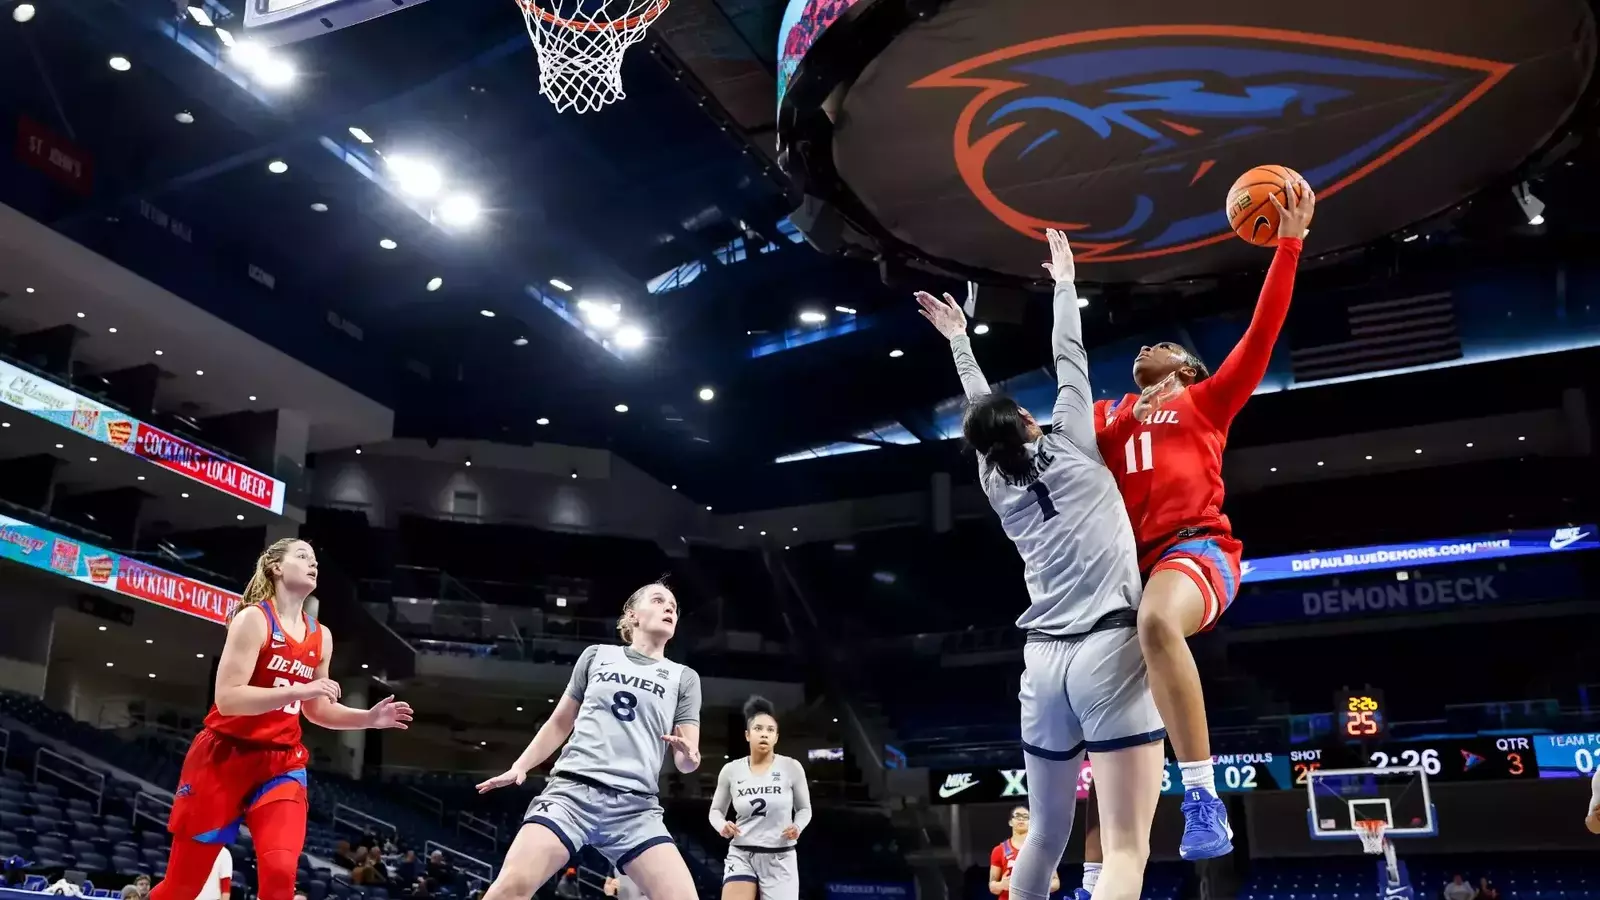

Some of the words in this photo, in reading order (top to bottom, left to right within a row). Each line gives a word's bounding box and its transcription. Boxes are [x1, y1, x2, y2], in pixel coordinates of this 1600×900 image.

[1140, 410, 1180, 426] AUL
[1124, 431, 1154, 475] 11
[143, 431, 202, 473] COCKTAILS
[206, 457, 237, 488] LOCAL
[240, 471, 267, 500] BEER
[1027, 479, 1060, 523] 1
[1554, 527, 1581, 541] NIKE
[126, 565, 186, 604] COCKTAILS
[191, 586, 223, 616] LOCAL
[1303, 583, 1409, 616] DEMON
[1414, 575, 1499, 606] DECK
[288, 659, 315, 680] PAUL
[596, 672, 666, 700] XAVIER
[611, 690, 638, 722] 8
[1349, 697, 1378, 711] 2:26
[1347, 711, 1377, 735] 25
[1496, 737, 1529, 751] QTR
[1549, 734, 1585, 747] TEAM
[1212, 754, 1235, 766] EAM
[1236, 752, 1273, 765] FOULS
[1290, 749, 1322, 761] SHOT
[1370, 748, 1441, 775] 2:26
[1507, 752, 1524, 775] 3
[944, 772, 973, 788] NIKE
[998, 769, 1028, 797] X
[1224, 765, 1258, 789] 02
[737, 786, 782, 798] XAVIER
[536, 802, 554, 812] X
[749, 797, 767, 817] 2
